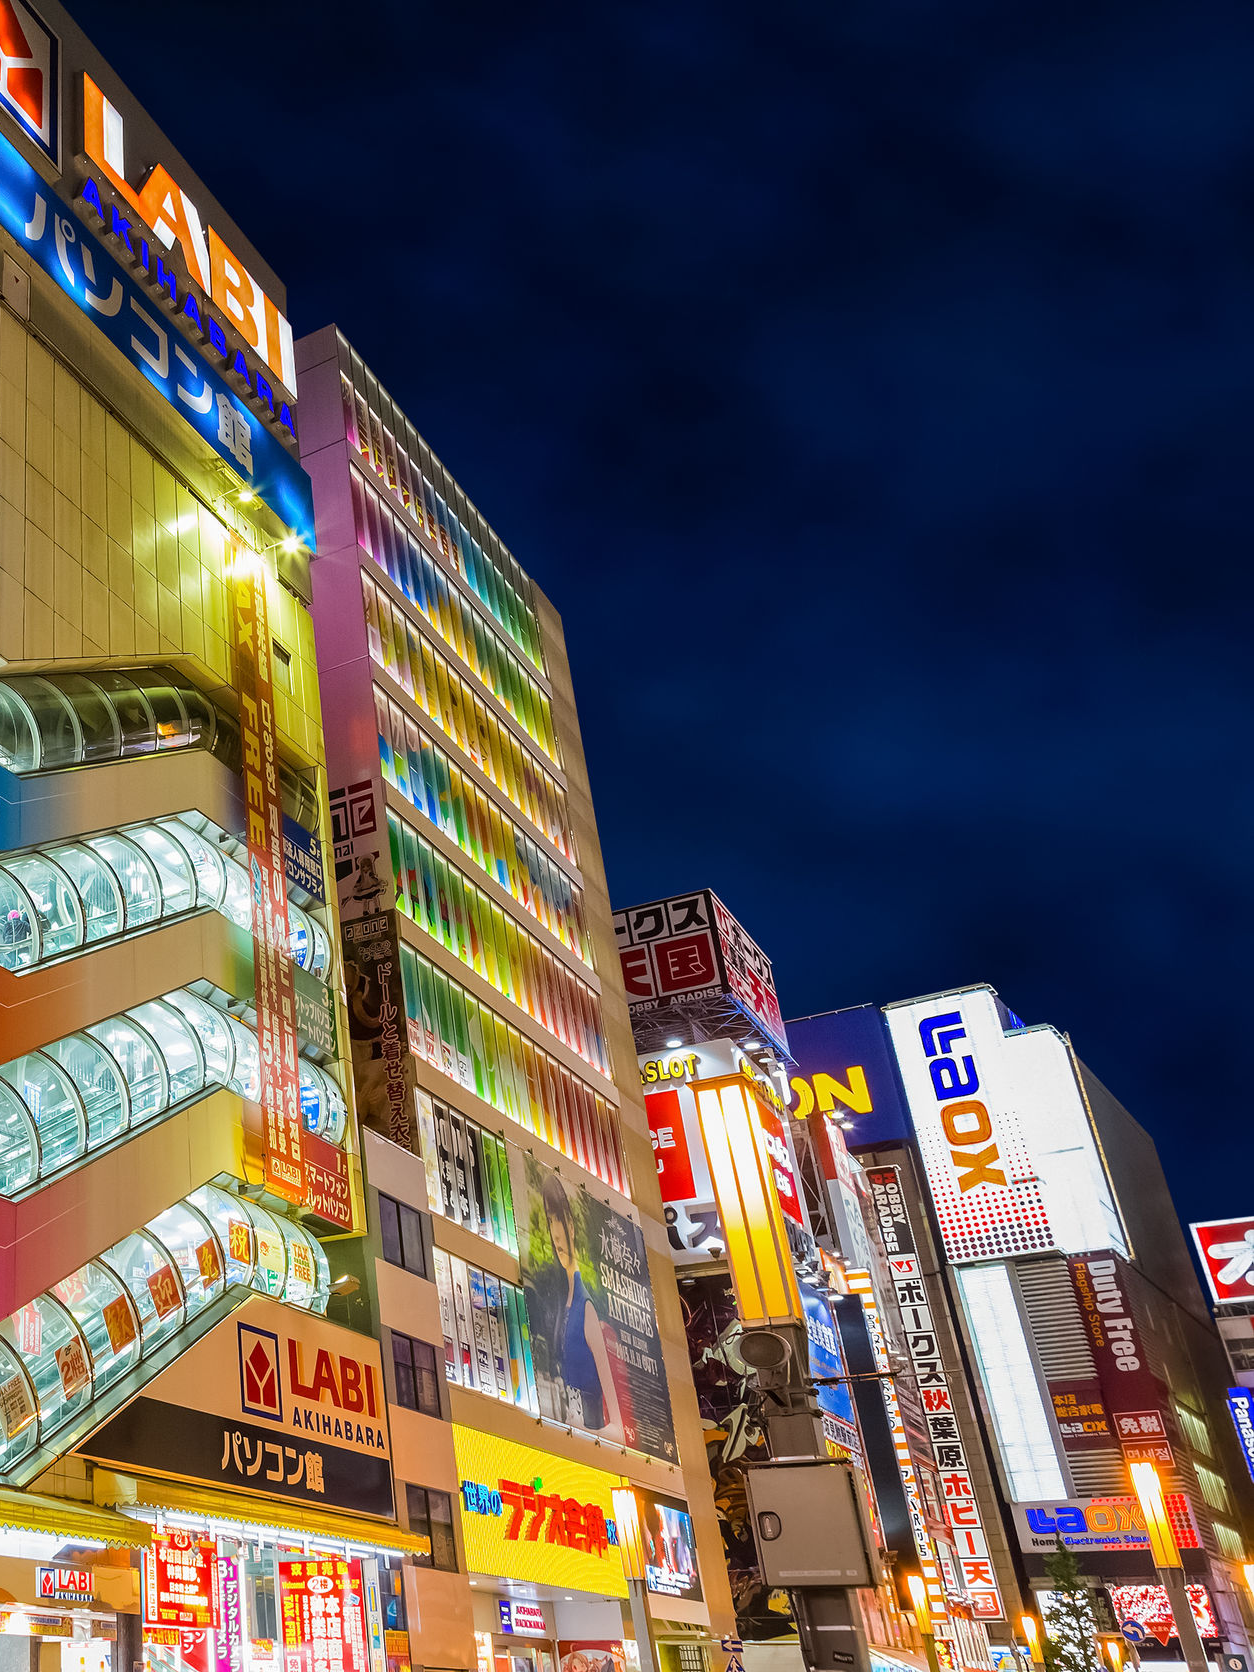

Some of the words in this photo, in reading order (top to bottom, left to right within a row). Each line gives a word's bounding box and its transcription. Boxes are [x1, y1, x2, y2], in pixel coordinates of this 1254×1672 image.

[84, 72, 298, 402] LABI
[82, 177, 297, 439] AKIHABARA
[24, 192, 254, 477] パソコン館
[310, 838, 321, 858] 5F
[322, 988, 333, 1010] 3F
[335, 1152, 347, 1176] 1F
[870, 1174, 900, 1253] PARADISE
[292, 1243, 309, 1261] TAX
[294, 1262, 311, 1281] FREE
[598, 1227, 642, 1276] 水樹奈々
[601, 1261, 652, 1312] SMASHING
[1074, 1262, 1095, 1312] Flagship
[1088, 1312, 1105, 1347] Store
[1087, 1259, 1125, 1314] Duty
[607, 1292, 655, 1339] ANTHEMS
[1104, 1317, 1141, 1372] Free
[286, 1337, 378, 1419] LABI
[1052, 1394, 1077, 1406] 本店
[292, 1406, 386, 1450] AKIHABARA
[898, 1280, 945, 1385] ボークス
[922, 1388, 1002, 1620] 秋葉原ホビー天国
[1119, 1416, 1161, 1434] 免税
[221, 1430, 326, 1494] パソコン館
[462, 1480, 503, 1517] 世界の
[497, 1478, 610, 1559] ラジオ会館
[58, 1568, 92, 1592] LABI
[226, 1581, 241, 1672] デジタルカメラ
[283, 1594, 295, 1618] TAX
[285, 1621, 298, 1652] FREE
